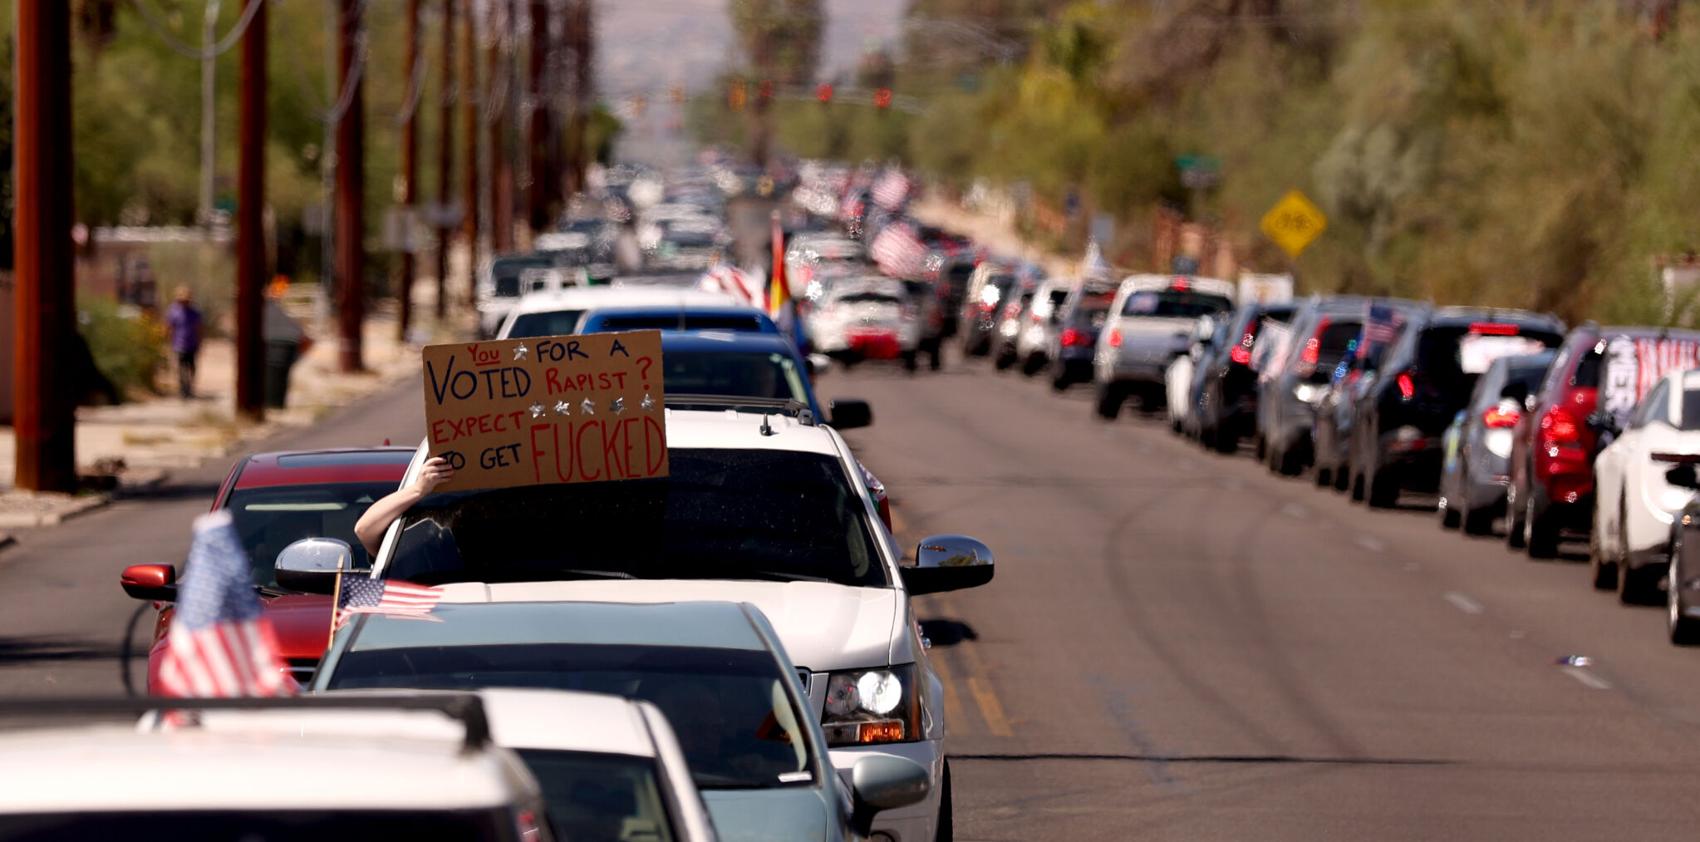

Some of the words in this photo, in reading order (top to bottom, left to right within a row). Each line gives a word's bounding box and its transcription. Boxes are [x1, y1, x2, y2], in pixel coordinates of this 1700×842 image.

[536, 340, 588, 363] FOR
[610, 339, 629, 357] A
[427, 355, 531, 405] VOTED
[432, 411, 524, 444] EXPECT
[438, 450, 466, 471] TO
[480, 443, 521, 470] GET
[530, 416, 665, 483] FUCKED
